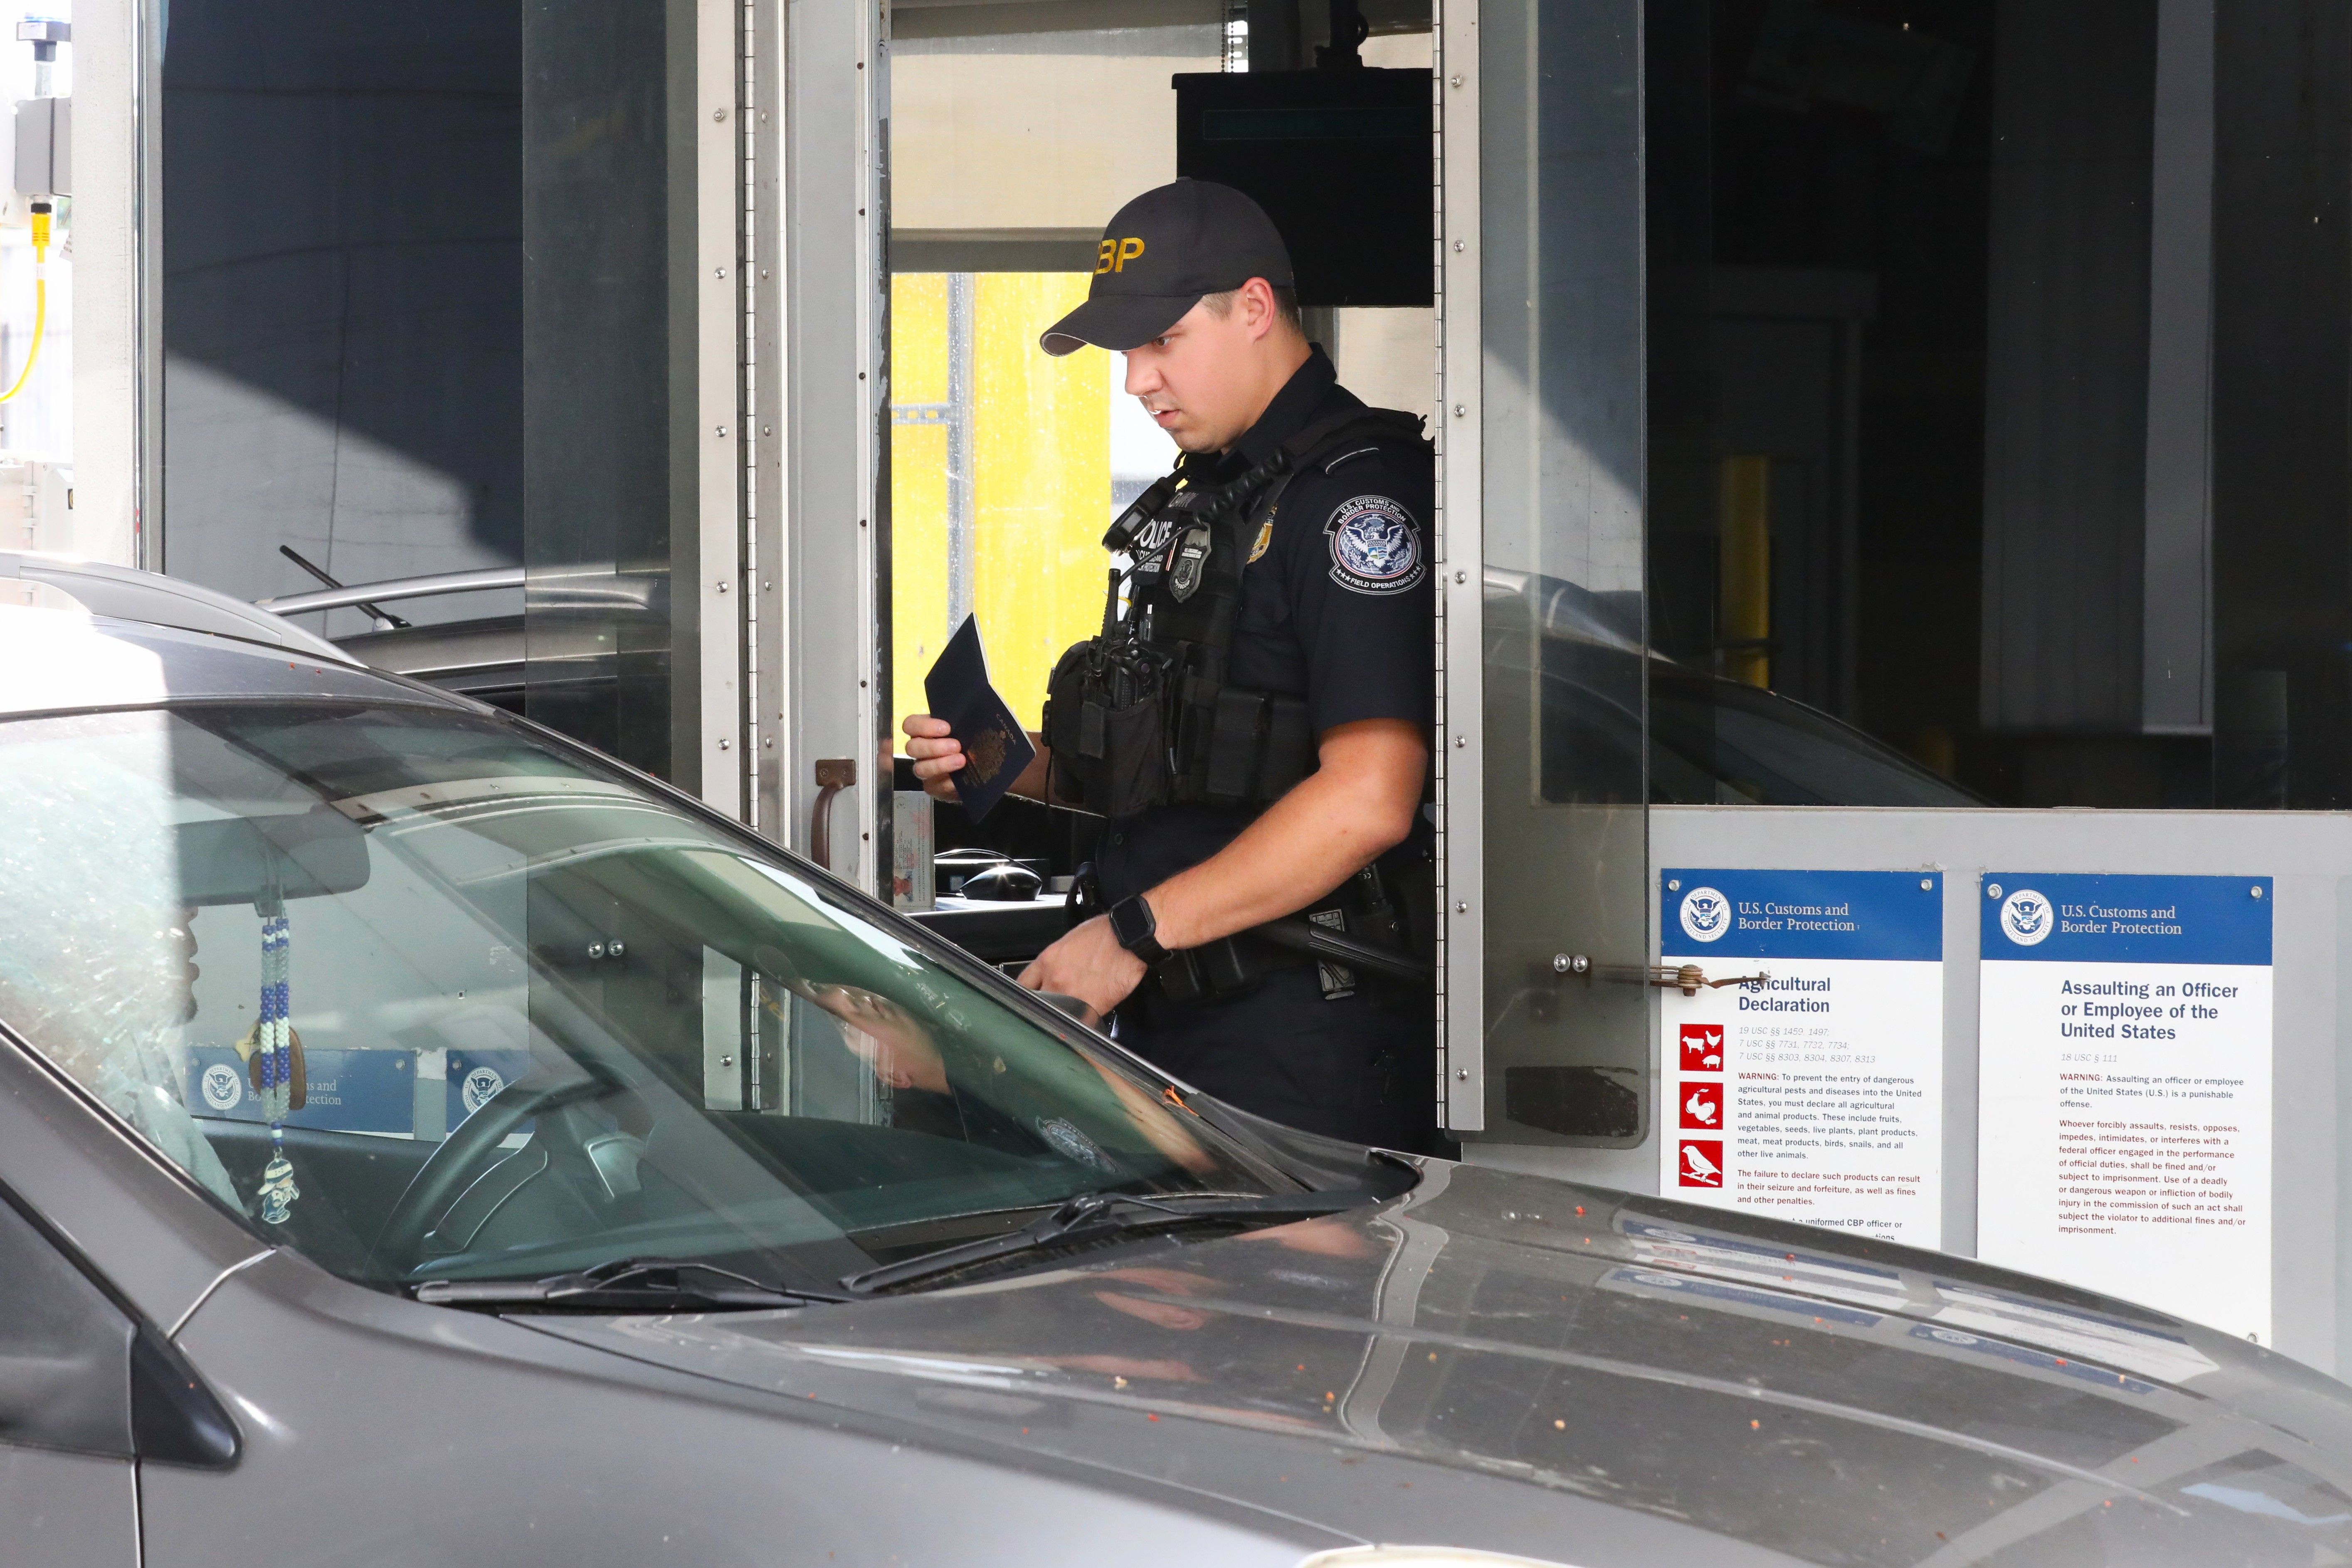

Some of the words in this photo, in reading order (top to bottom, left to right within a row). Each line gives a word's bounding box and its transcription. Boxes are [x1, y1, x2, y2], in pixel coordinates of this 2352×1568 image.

[1093, 237, 1145, 275] BP
[1338, 505, 1364, 524] BORDER
[1365, 504, 1407, 522] PROTECTION
[1340, 504, 1354, 514] U.S.
[1140, 521, 1172, 549] OLICE
[1350, 578, 1370, 588] FIELD
[1371, 575, 1411, 589] OPERATIONS
[996, 714, 1016, 745] CANADA
[1691, 890, 1724, 903] DEPARTMENT
[1739, 902, 1762, 914] U.S.
[1765, 903, 1821, 915] Customs
[1825, 903, 1849, 915] and
[2061, 905, 2086, 917] U.S.
[2089, 906, 2147, 918] Customs
[2151, 906, 2176, 919] and
[1683, 917, 1706, 939] HOMELAND
[1708, 918, 1728, 938] SECURITY
[1739, 918, 1782, 929] Border
[1787, 919, 1855, 931] Protection
[2061, 921, 2107, 933] Border
[2112, 921, 2182, 934] Protection
[2061, 980, 2149, 999] Assaulting
[2156, 985, 2175, 996] an
[2182, 983, 2238, 998] Officer
[1740, 997, 1829, 1012] Declaration
[2061, 1005, 2077, 1015] or
[2084, 1002, 2162, 1020] Employee
[2169, 1004, 2185, 1018] of
[2191, 1005, 2218, 1019] the
[2062, 1023, 2114, 1038] United
[2121, 1024, 2175, 1039] States
[1779, 1040, 1799, 1049] 7731,
[1829, 1042, 1850, 1050] 7734;
[1778, 1053, 1801, 1062] 8303,
[1804, 1054, 1827, 1062] 8304,
[1830, 1054, 1851, 1063] 8307,
[1854, 1055, 1876, 1063] 8313
[2094, 1054, 2099, 1063] §
[317, 1079, 336, 1091] and
[1873, 1076, 1914, 1084] dangerous
[2107, 1075, 2149, 1084] Assaulting
[2205, 1078, 2243, 1086] employee
[2146, 1089, 2168, 1098] (U.S.)
[2097, 1121, 2126, 1130] forcibly
[2060, 1133, 2095, 1141] impedes,
[2059, 1212, 2088, 1221] subject
[1866, 1220, 1892, 1228] officer
